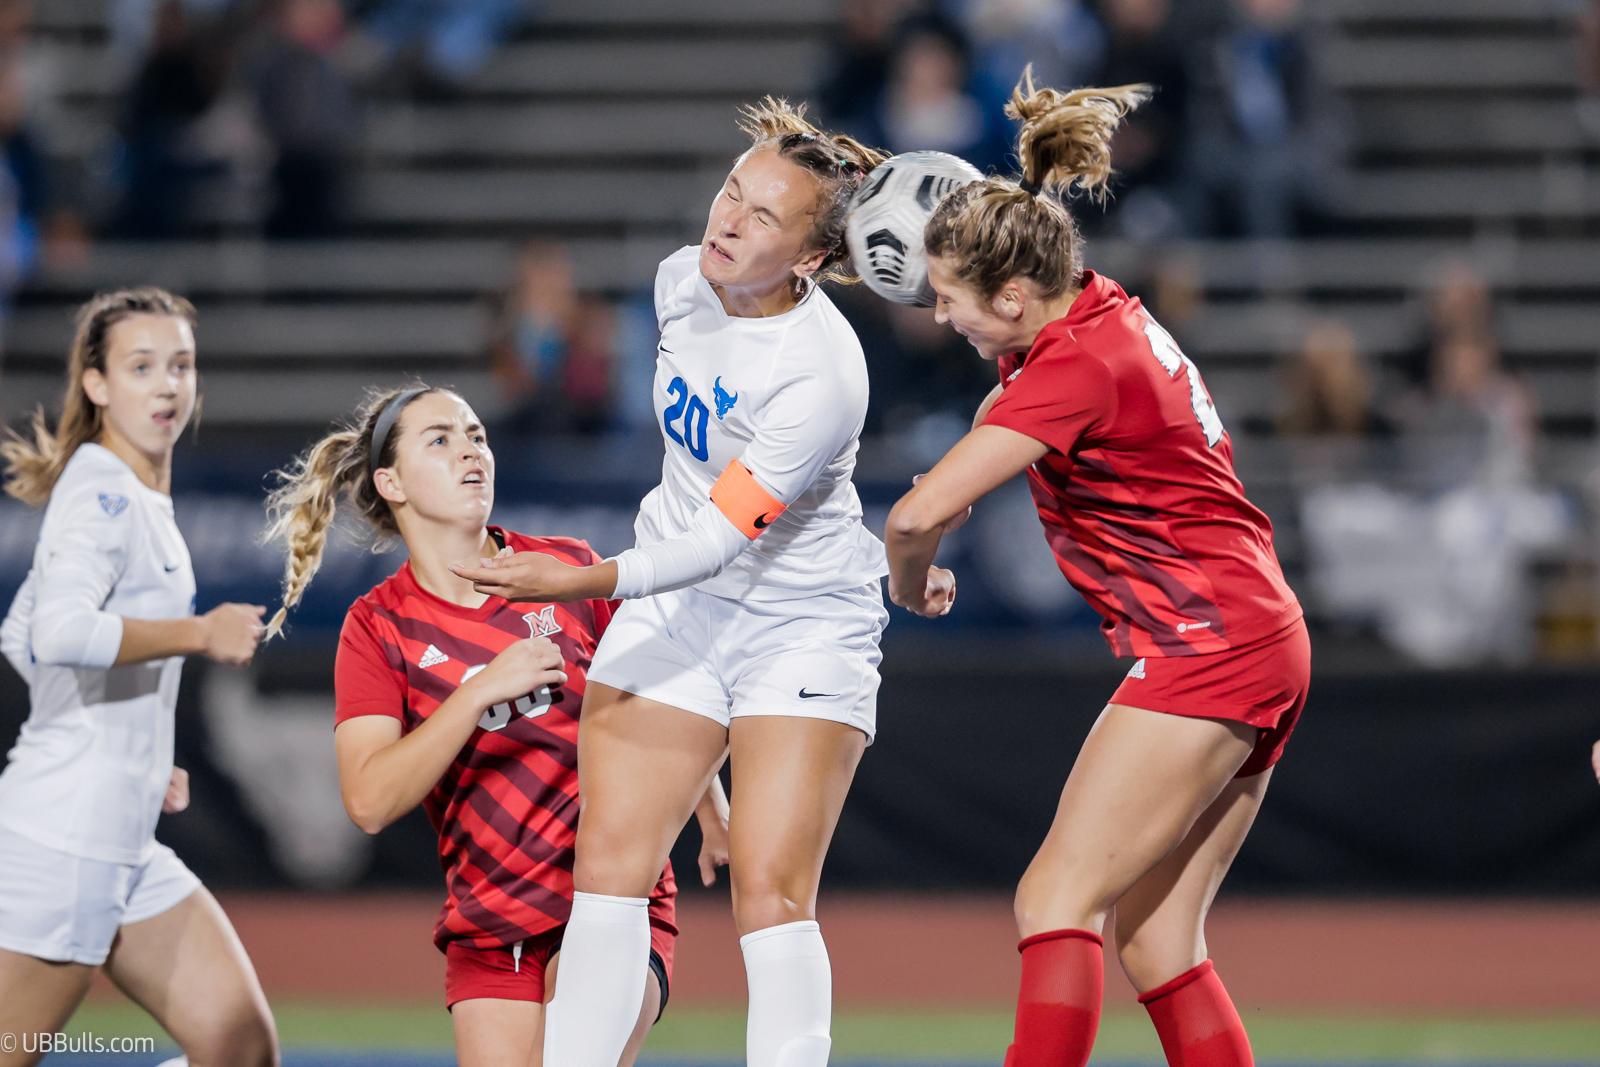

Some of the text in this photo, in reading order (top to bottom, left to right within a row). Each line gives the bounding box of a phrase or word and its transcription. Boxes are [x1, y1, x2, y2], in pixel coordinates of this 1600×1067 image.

[663, 376, 709, 462] 20
[522, 605, 562, 638] M
[418, 653, 450, 669] adidas
